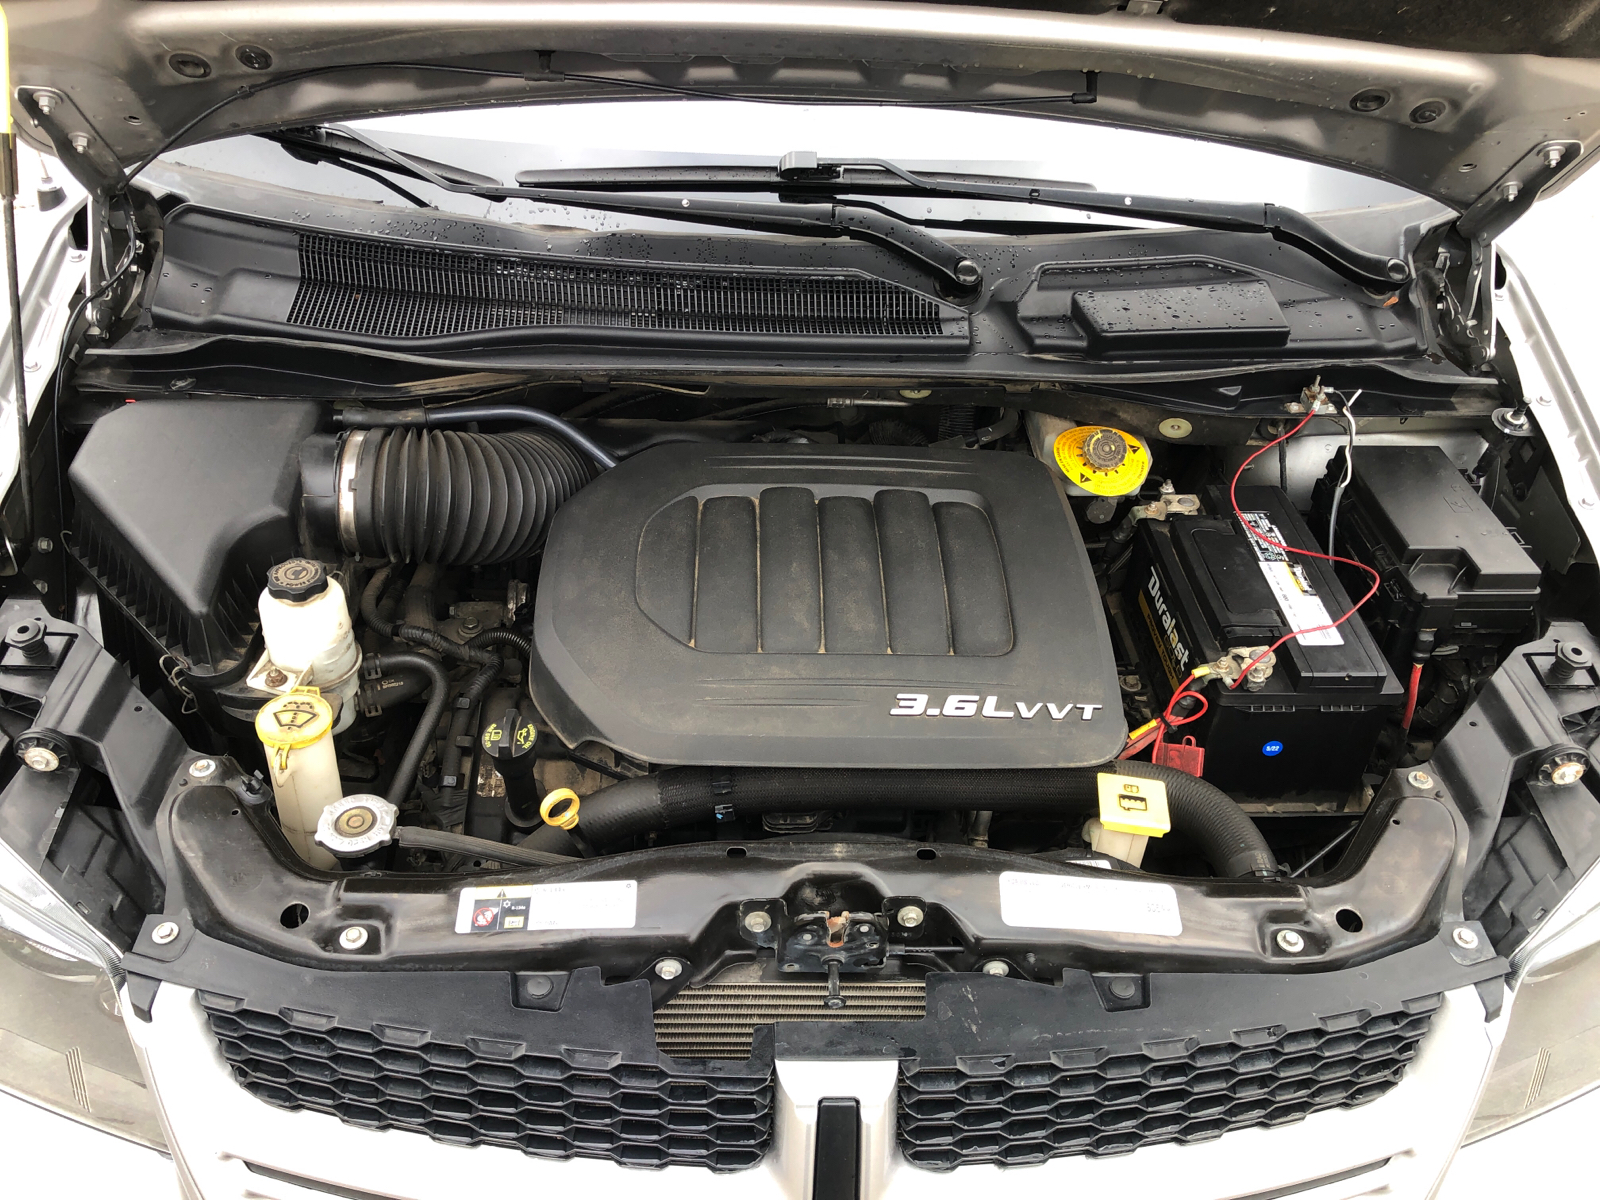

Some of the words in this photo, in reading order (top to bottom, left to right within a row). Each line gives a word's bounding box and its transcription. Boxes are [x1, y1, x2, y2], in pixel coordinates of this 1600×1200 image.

[1147, 565, 1190, 672] Duralast
[1147, 612, 1162, 648] PROVEN
[1161, 650, 1175, 681] TOUGH
[889, 693, 1015, 718] 3.6L
[1015, 701, 1103, 721] VVT
